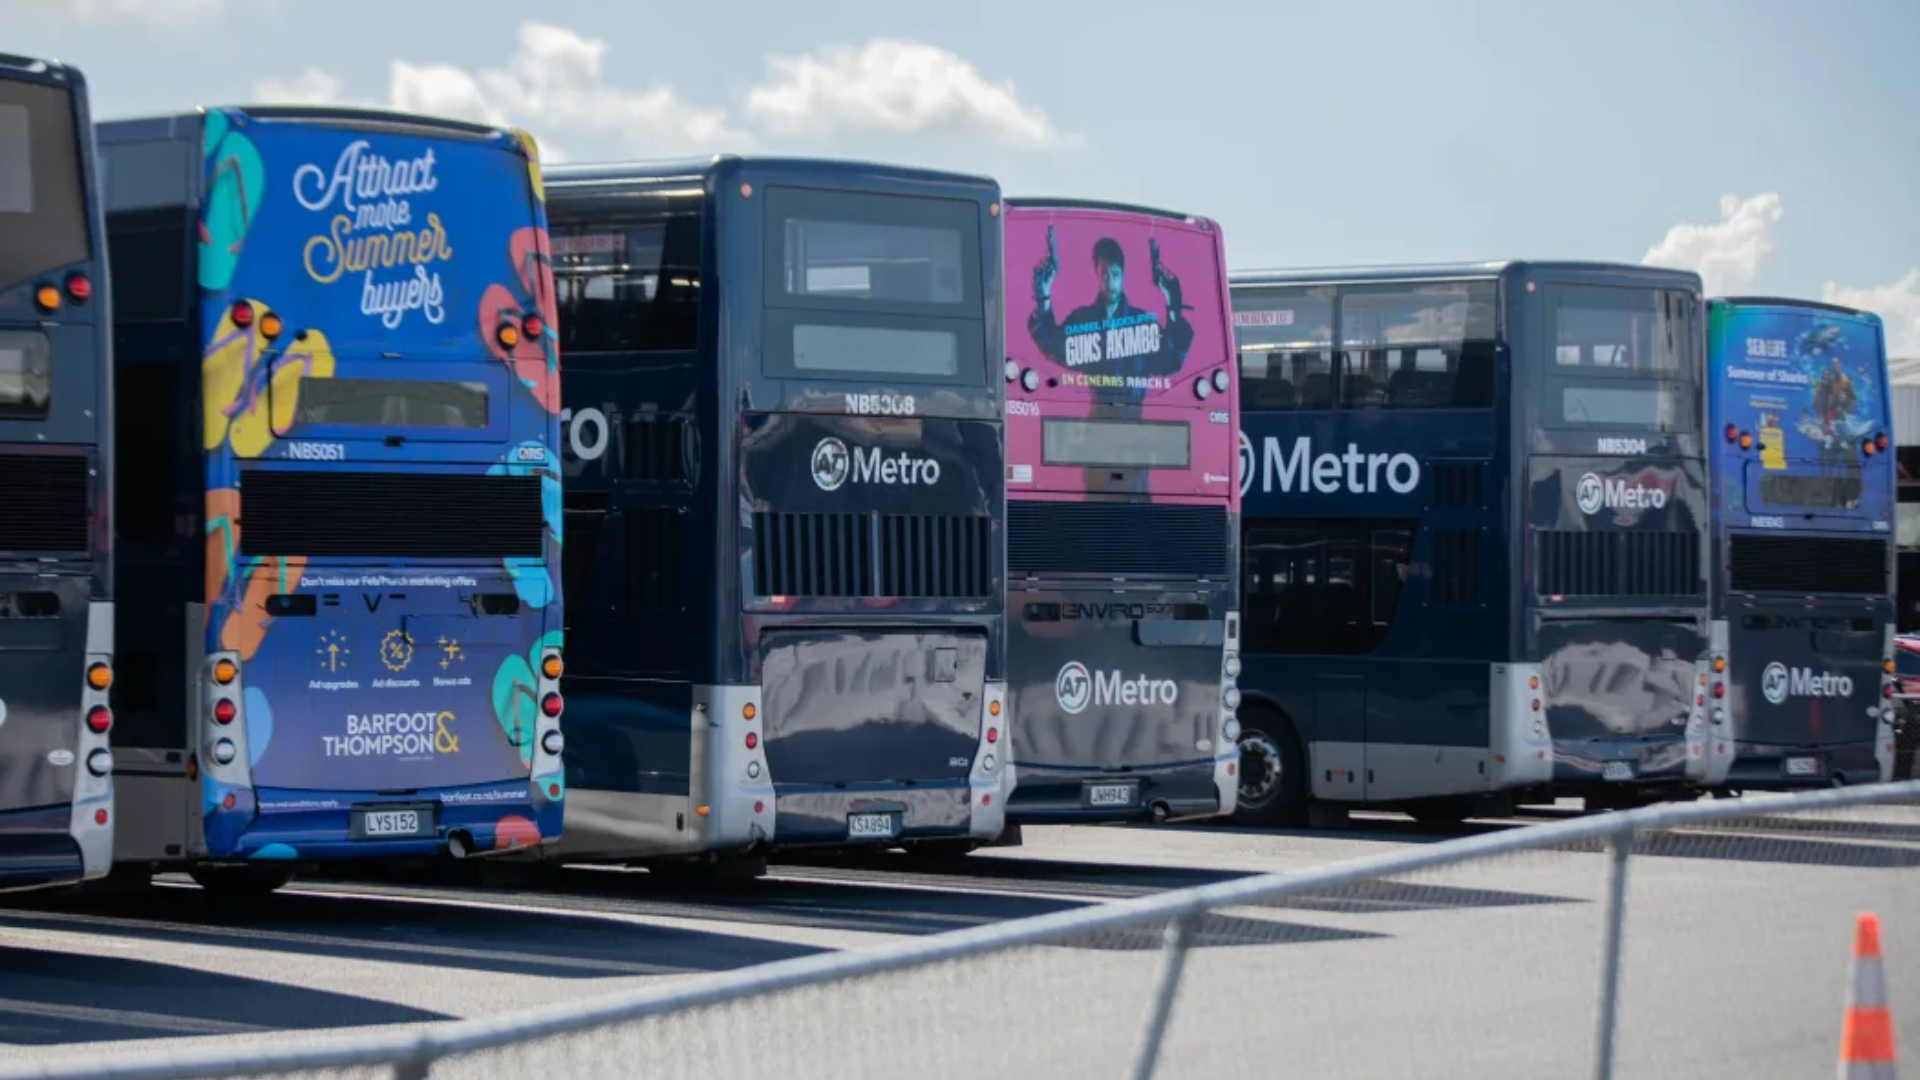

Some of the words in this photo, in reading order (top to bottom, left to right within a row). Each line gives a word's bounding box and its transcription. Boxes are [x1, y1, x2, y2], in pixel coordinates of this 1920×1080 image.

[293, 140, 437, 211] Attract
[355, 198, 412, 230] more
[304, 213, 453, 283] Summer
[361, 264, 445, 328] buyers
[1064, 321, 1100, 336] DANIEL
[1065, 333, 1101, 366] GUNS
[1106, 323, 1160, 359] AKIMBO
[1062, 374, 1074, 385] IN
[1077, 375, 1124, 387] CINEMAS
[1126, 376, 1162, 388] MARCH
[845, 393, 915, 415] NB5308
[289, 442, 345, 461] NB5051
[1597, 437, 1647, 454] NB5304
[853, 446, 941, 485] Metro
[1263, 436, 1420, 494] Metro
[1605, 479, 1666, 509] Metro
[301, 577, 324, 586] Don't
[325, 578, 344, 586] miss
[410, 577, 451, 588] marketing
[452, 577, 477, 586] offers
[1094, 669, 1178, 705] Metro
[1790, 667, 1853, 698] Metro
[322, 733, 434, 756] THOMPSON
[347, 712, 437, 734] BARFOOT
[435, 711, 459, 753] &
[367, 812, 417, 832] LYS152
[851, 815, 890, 834] KSA894
